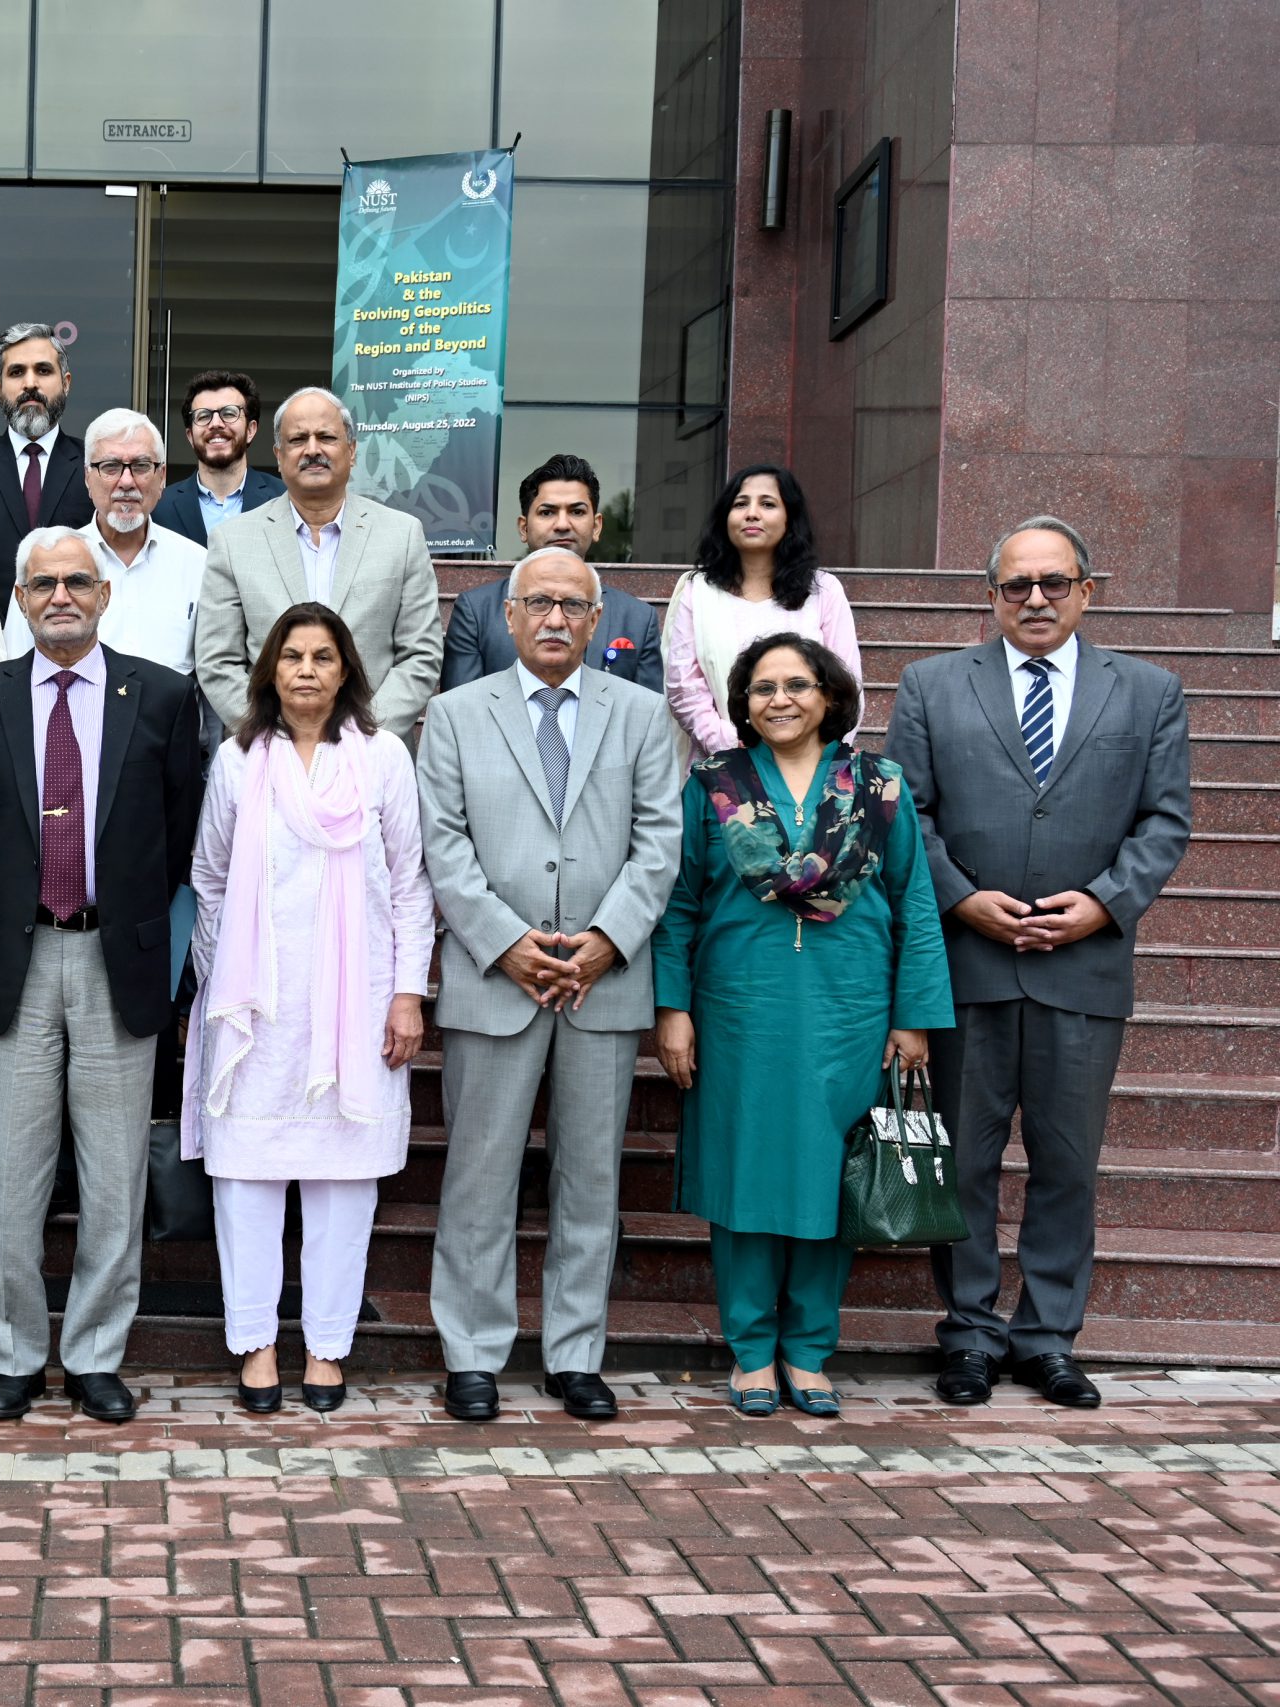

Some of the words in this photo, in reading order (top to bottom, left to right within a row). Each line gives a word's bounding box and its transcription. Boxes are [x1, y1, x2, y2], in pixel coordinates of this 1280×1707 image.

[108, 124, 187, 137] ENTRANCE-1
[359, 193, 397, 207] NUST
[394, 270, 452, 285] Pakistan
[402, 289, 415, 301] &
[419, 287, 442, 300] the
[353, 307, 410, 322] Evolving
[414, 302, 491, 319] Geopolitics
[399, 323, 415, 336] of
[418, 322, 441, 335] the
[354, 342, 401, 358] Region
[405, 339, 431, 353] and
[435, 336, 487, 352] Beyond
[392, 367, 432, 378] Organized
[434, 366, 444, 376] by
[351, 383, 365, 391] The
[366, 382, 387, 391] NUST
[389, 381, 421, 390] Institute
[423, 380, 432, 389] of
[433, 378, 457, 389] Policy
[458, 377, 488, 387] Studies
[405, 393, 430, 403] (NIPS)
[357, 422, 400, 433] Thursday,
[402, 420, 435, 432] August
[436, 419, 451, 430] 25,
[453, 418, 476, 428] 2022
[426, 538, 475, 547] w.nust.edu.pk
